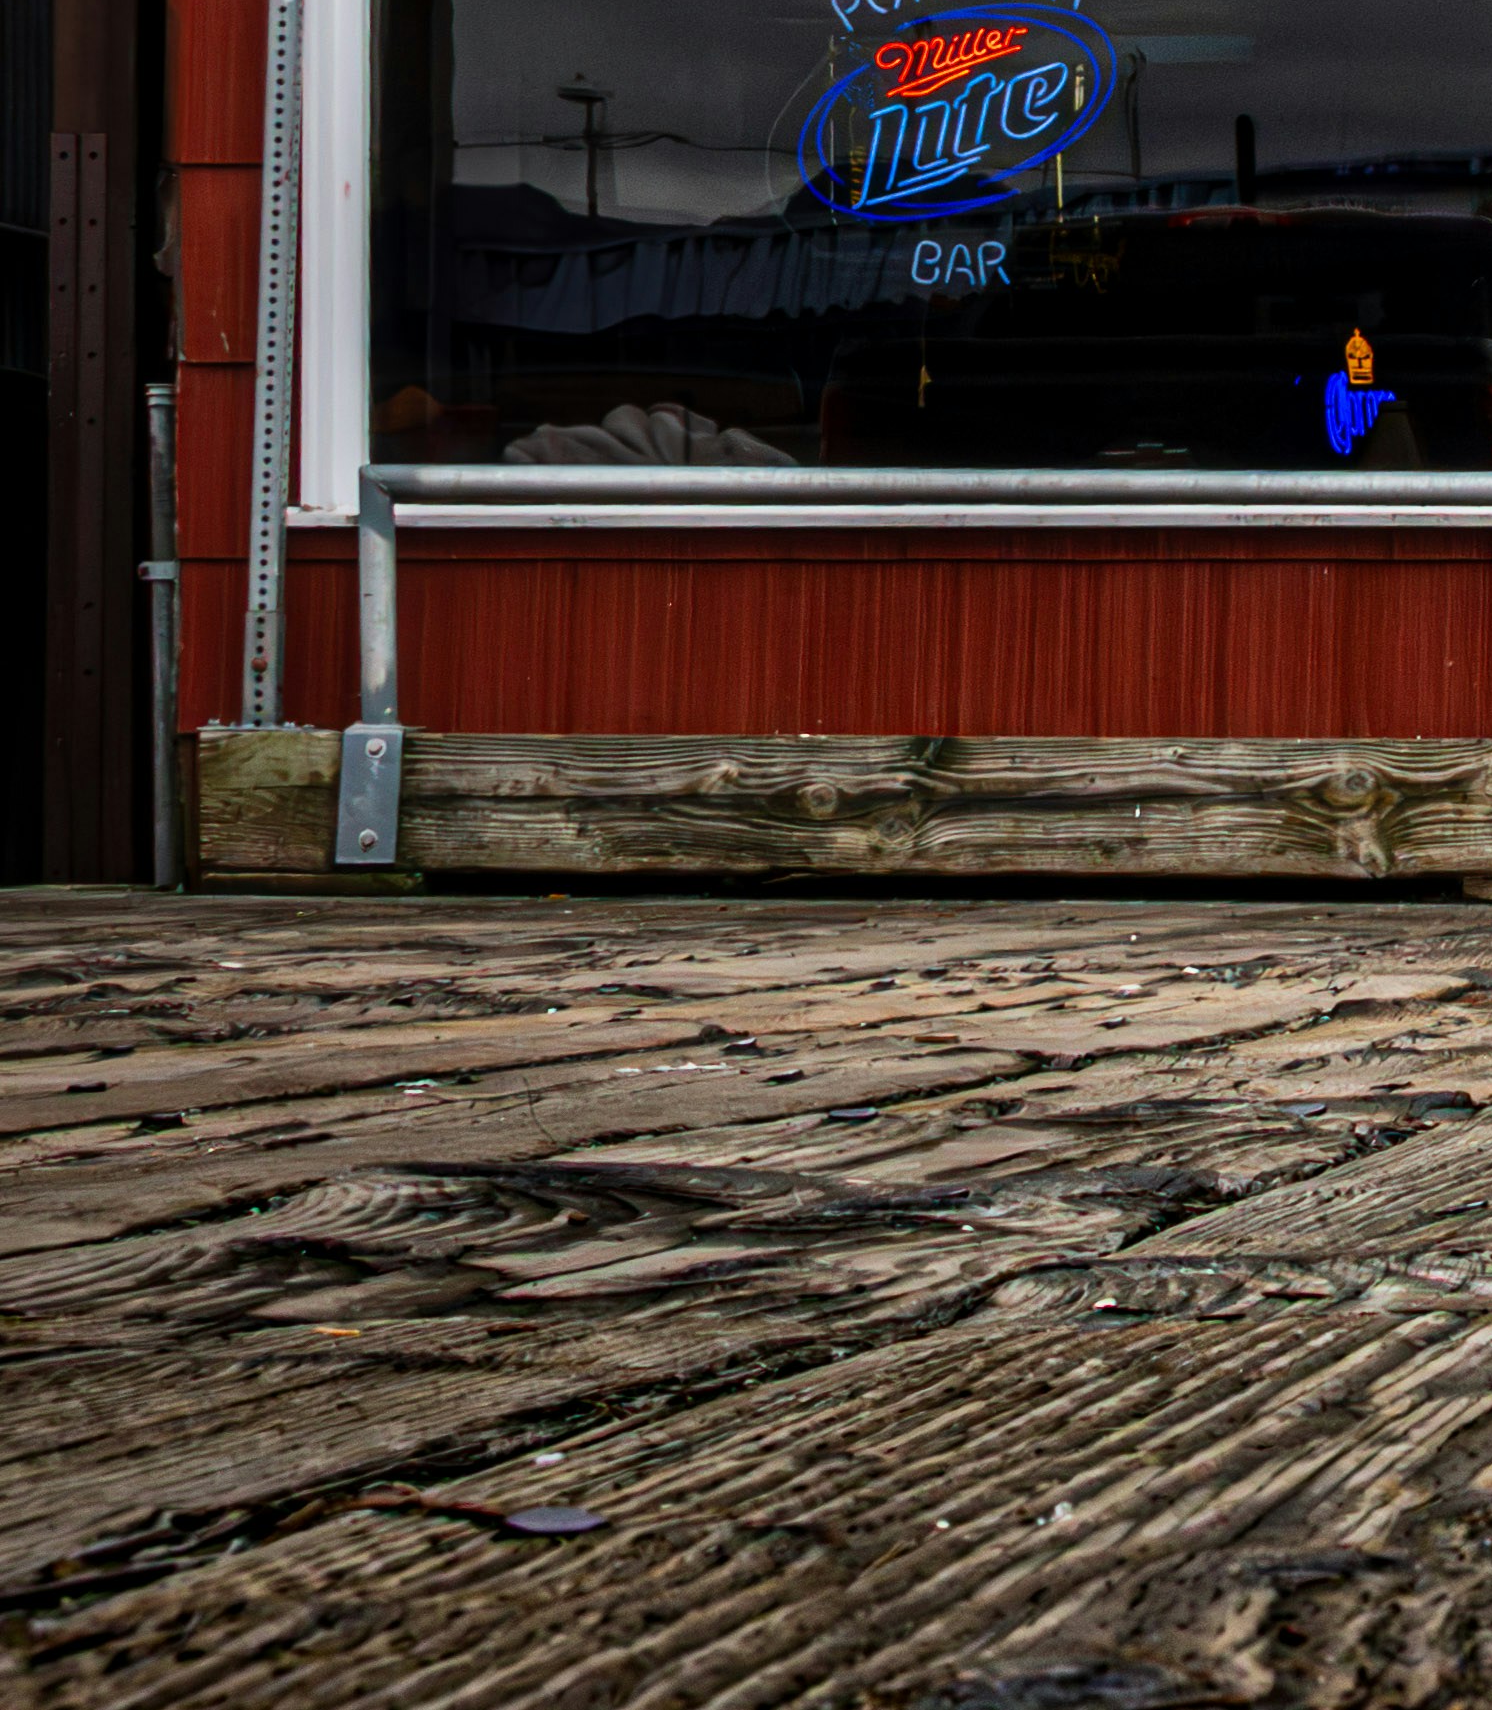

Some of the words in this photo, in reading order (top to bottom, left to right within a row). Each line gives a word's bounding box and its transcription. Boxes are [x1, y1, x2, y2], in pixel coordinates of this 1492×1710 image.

[873, 27, 1030, 83] Miller
[851, 61, 1069, 210] Lite
[910, 239, 1011, 285] BAR
